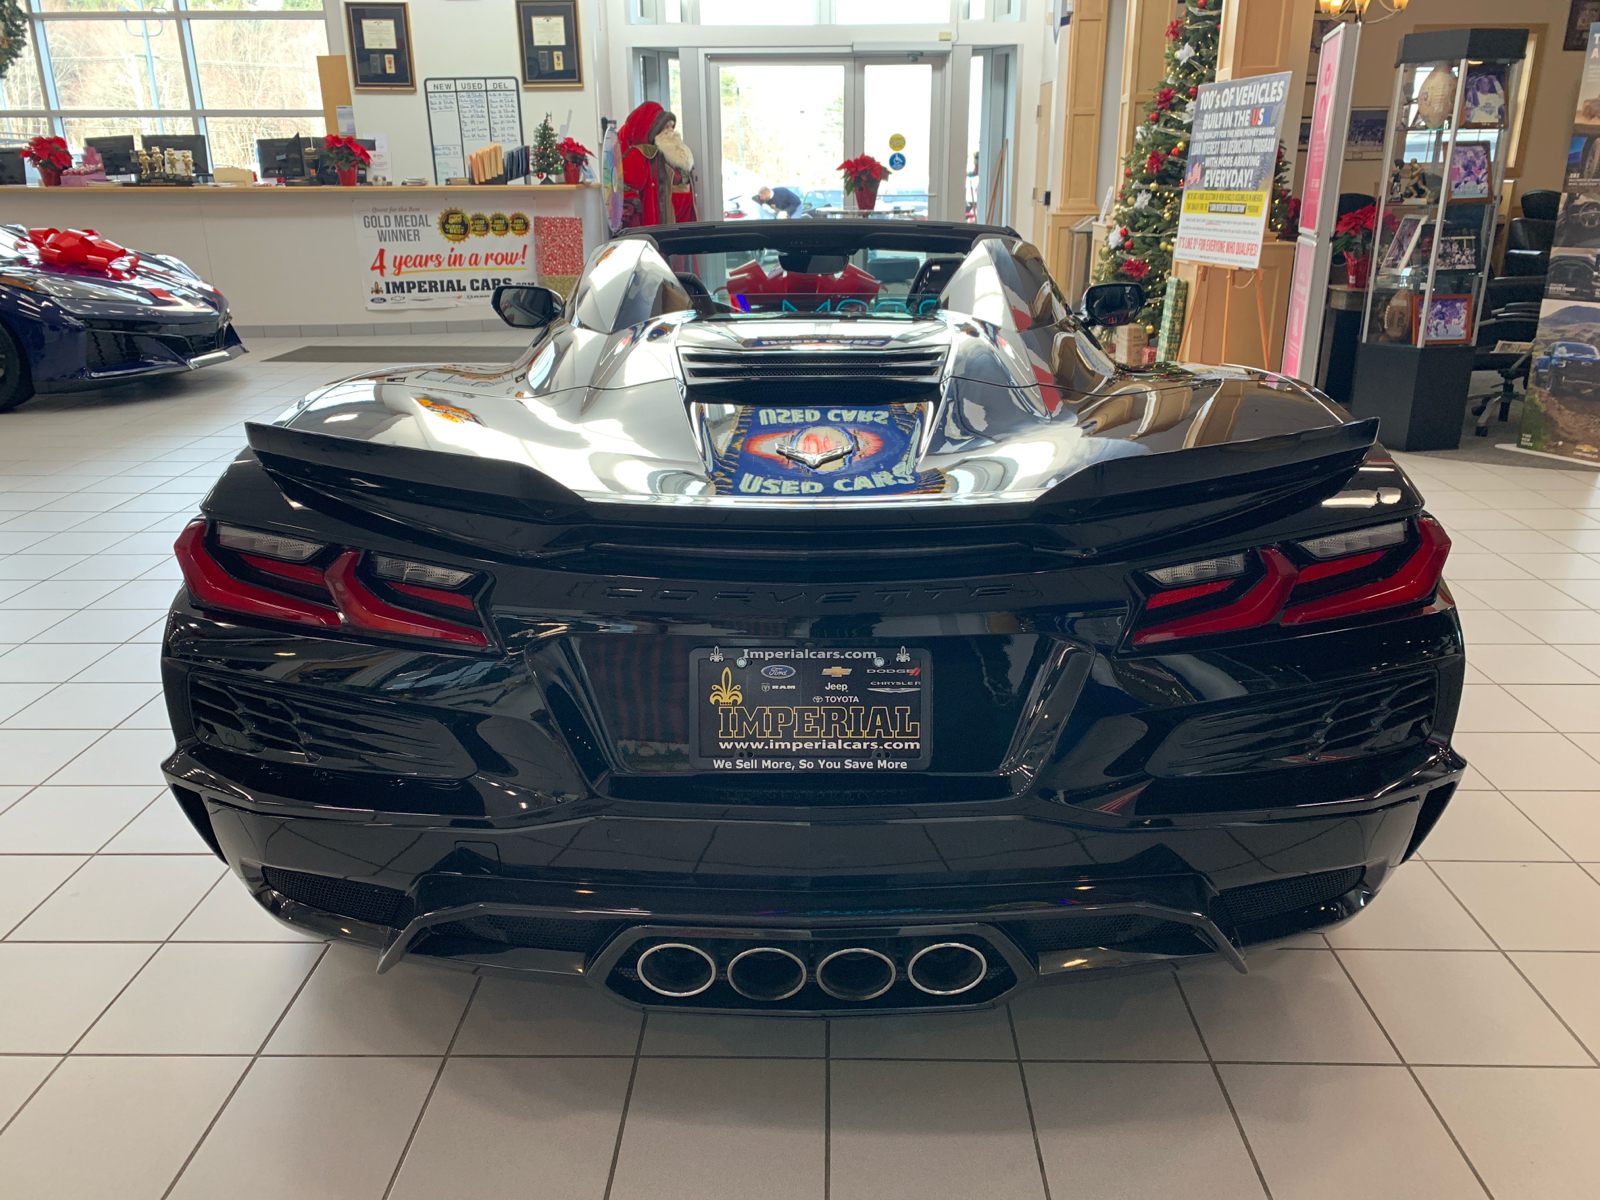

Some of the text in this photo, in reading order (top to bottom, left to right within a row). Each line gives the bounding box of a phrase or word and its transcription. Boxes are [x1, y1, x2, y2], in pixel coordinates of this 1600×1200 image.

[1200, 81, 1284, 110] 100's OF VEHICLES
[1202, 107, 1270, 130] BUILT IN THE USA
[1218, 156, 1233, 167] MORE
[1232, 156, 1260, 166] ARRIVING
[1204, 168, 1254, 188] EVERYDAY!
[363, 215, 391, 228] GOLD
[394, 214, 431, 228] MEDAL
[377, 229, 420, 242] WINNER
[370, 244, 527, 277] 4 years in a row!
[385, 279, 466, 294] IMPERIAL
[739, 469, 916, 494] USED CARS
[604, 584, 1014, 604] CORVETTE
[743, 649, 876, 660] Imperialcars.com
[825, 682, 848, 691] Jeep
[719, 706, 920, 738] IMPERIAL
[719, 739, 920, 751] www.imperialcars.com
[713, 759, 907, 770] We Sell More, So You Save More
